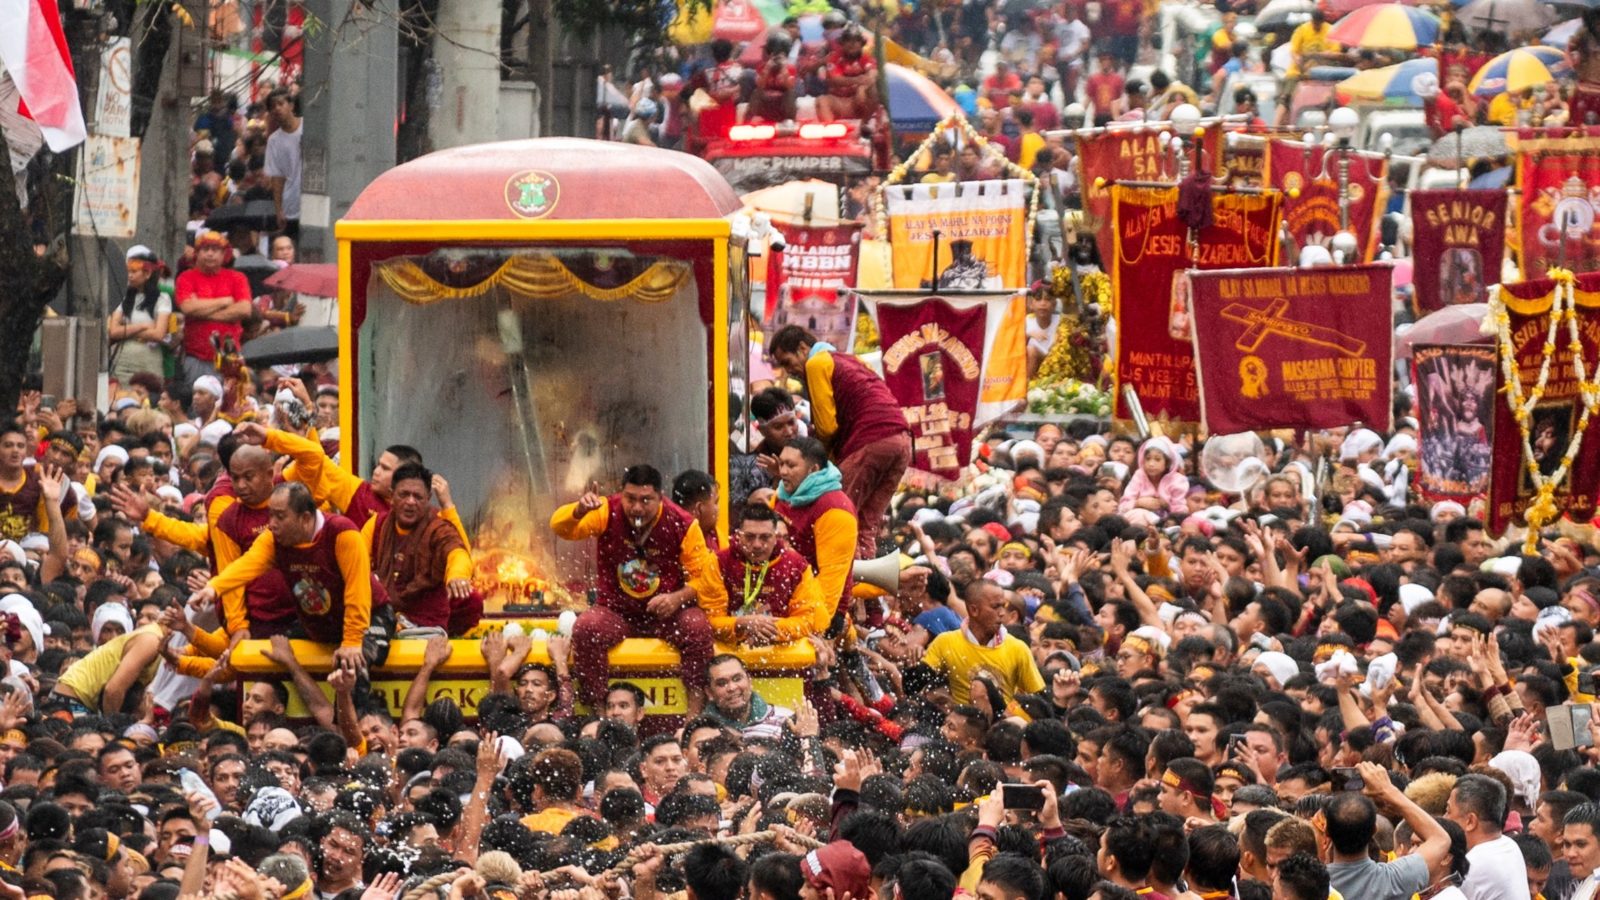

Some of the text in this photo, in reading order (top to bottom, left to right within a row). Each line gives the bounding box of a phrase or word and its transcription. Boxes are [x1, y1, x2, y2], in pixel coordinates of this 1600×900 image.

[772, 156, 842, 170] PUMPER
[1134, 155, 1159, 175] SA
[1427, 200, 1496, 230] SENIOR
[1145, 234, 1181, 256] JESUS
[1444, 224, 1480, 245] AWA
[782, 255, 852, 271] MBBN
[1282, 357, 1376, 380] MASAGANA CHAPTER
